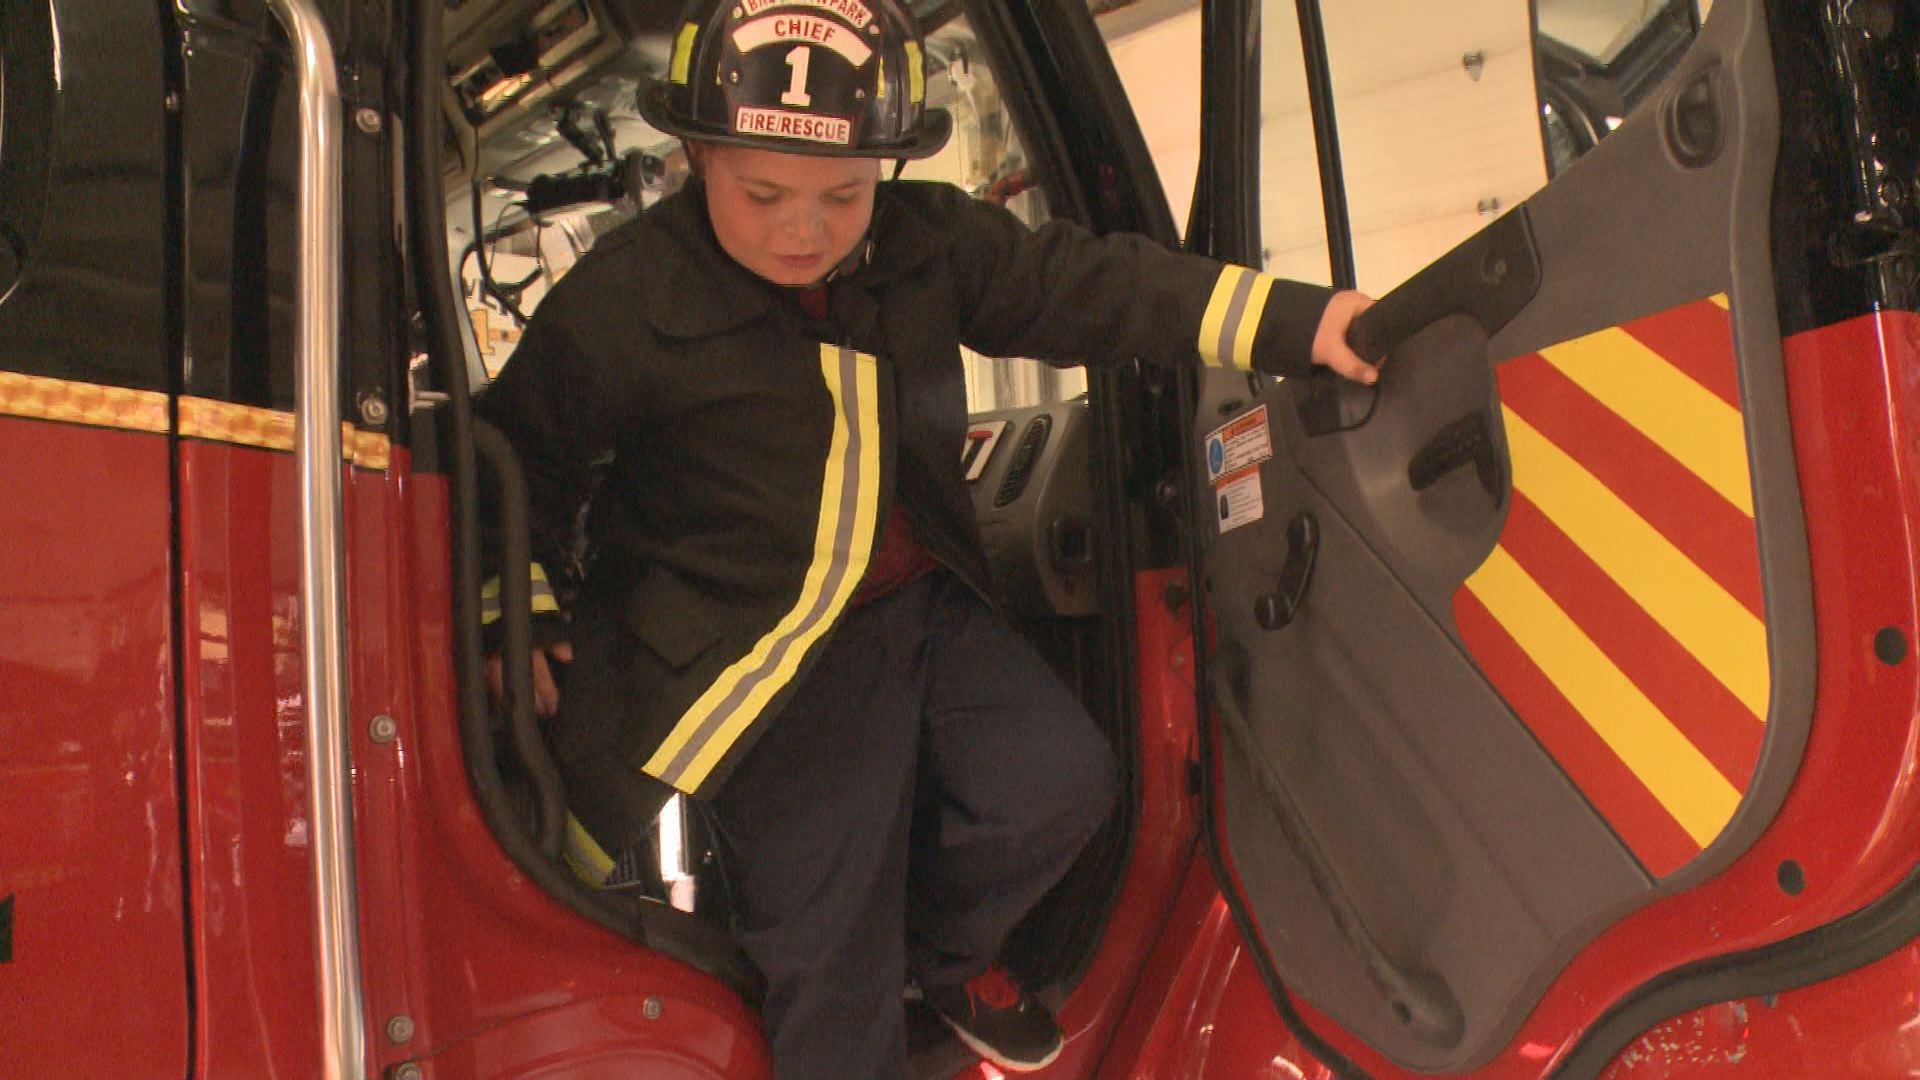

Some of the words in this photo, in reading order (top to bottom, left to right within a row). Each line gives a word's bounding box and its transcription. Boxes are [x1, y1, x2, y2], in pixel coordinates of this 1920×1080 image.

[774, 19, 836, 43] CHIEF
[781, 46, 811, 107] 1
[739, 112, 848, 142] FIRE/RESCUE
